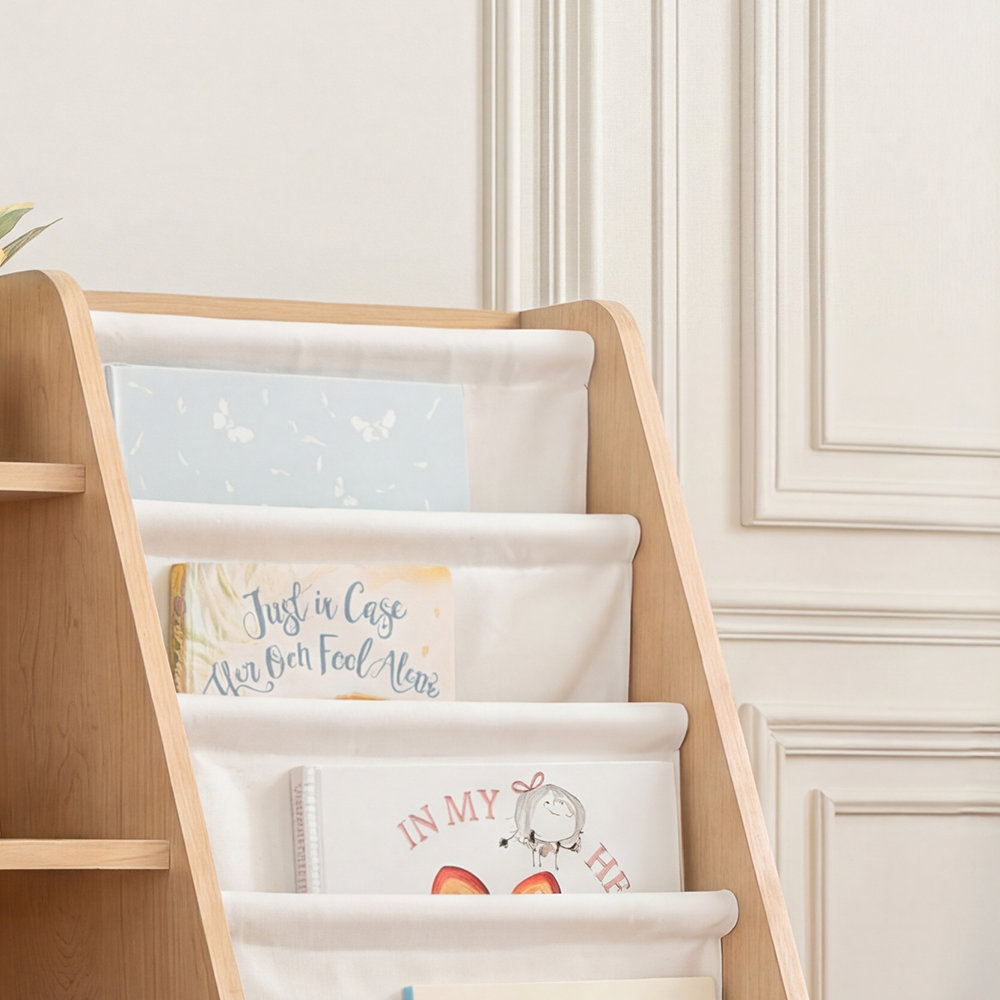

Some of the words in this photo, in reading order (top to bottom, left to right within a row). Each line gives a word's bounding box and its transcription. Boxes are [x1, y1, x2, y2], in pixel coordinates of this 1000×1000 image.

[242, 581, 312, 640] Just
[344, 581, 408, 639] Case
[397, 805, 440, 850] IN
[443, 789, 499, 826] MY
